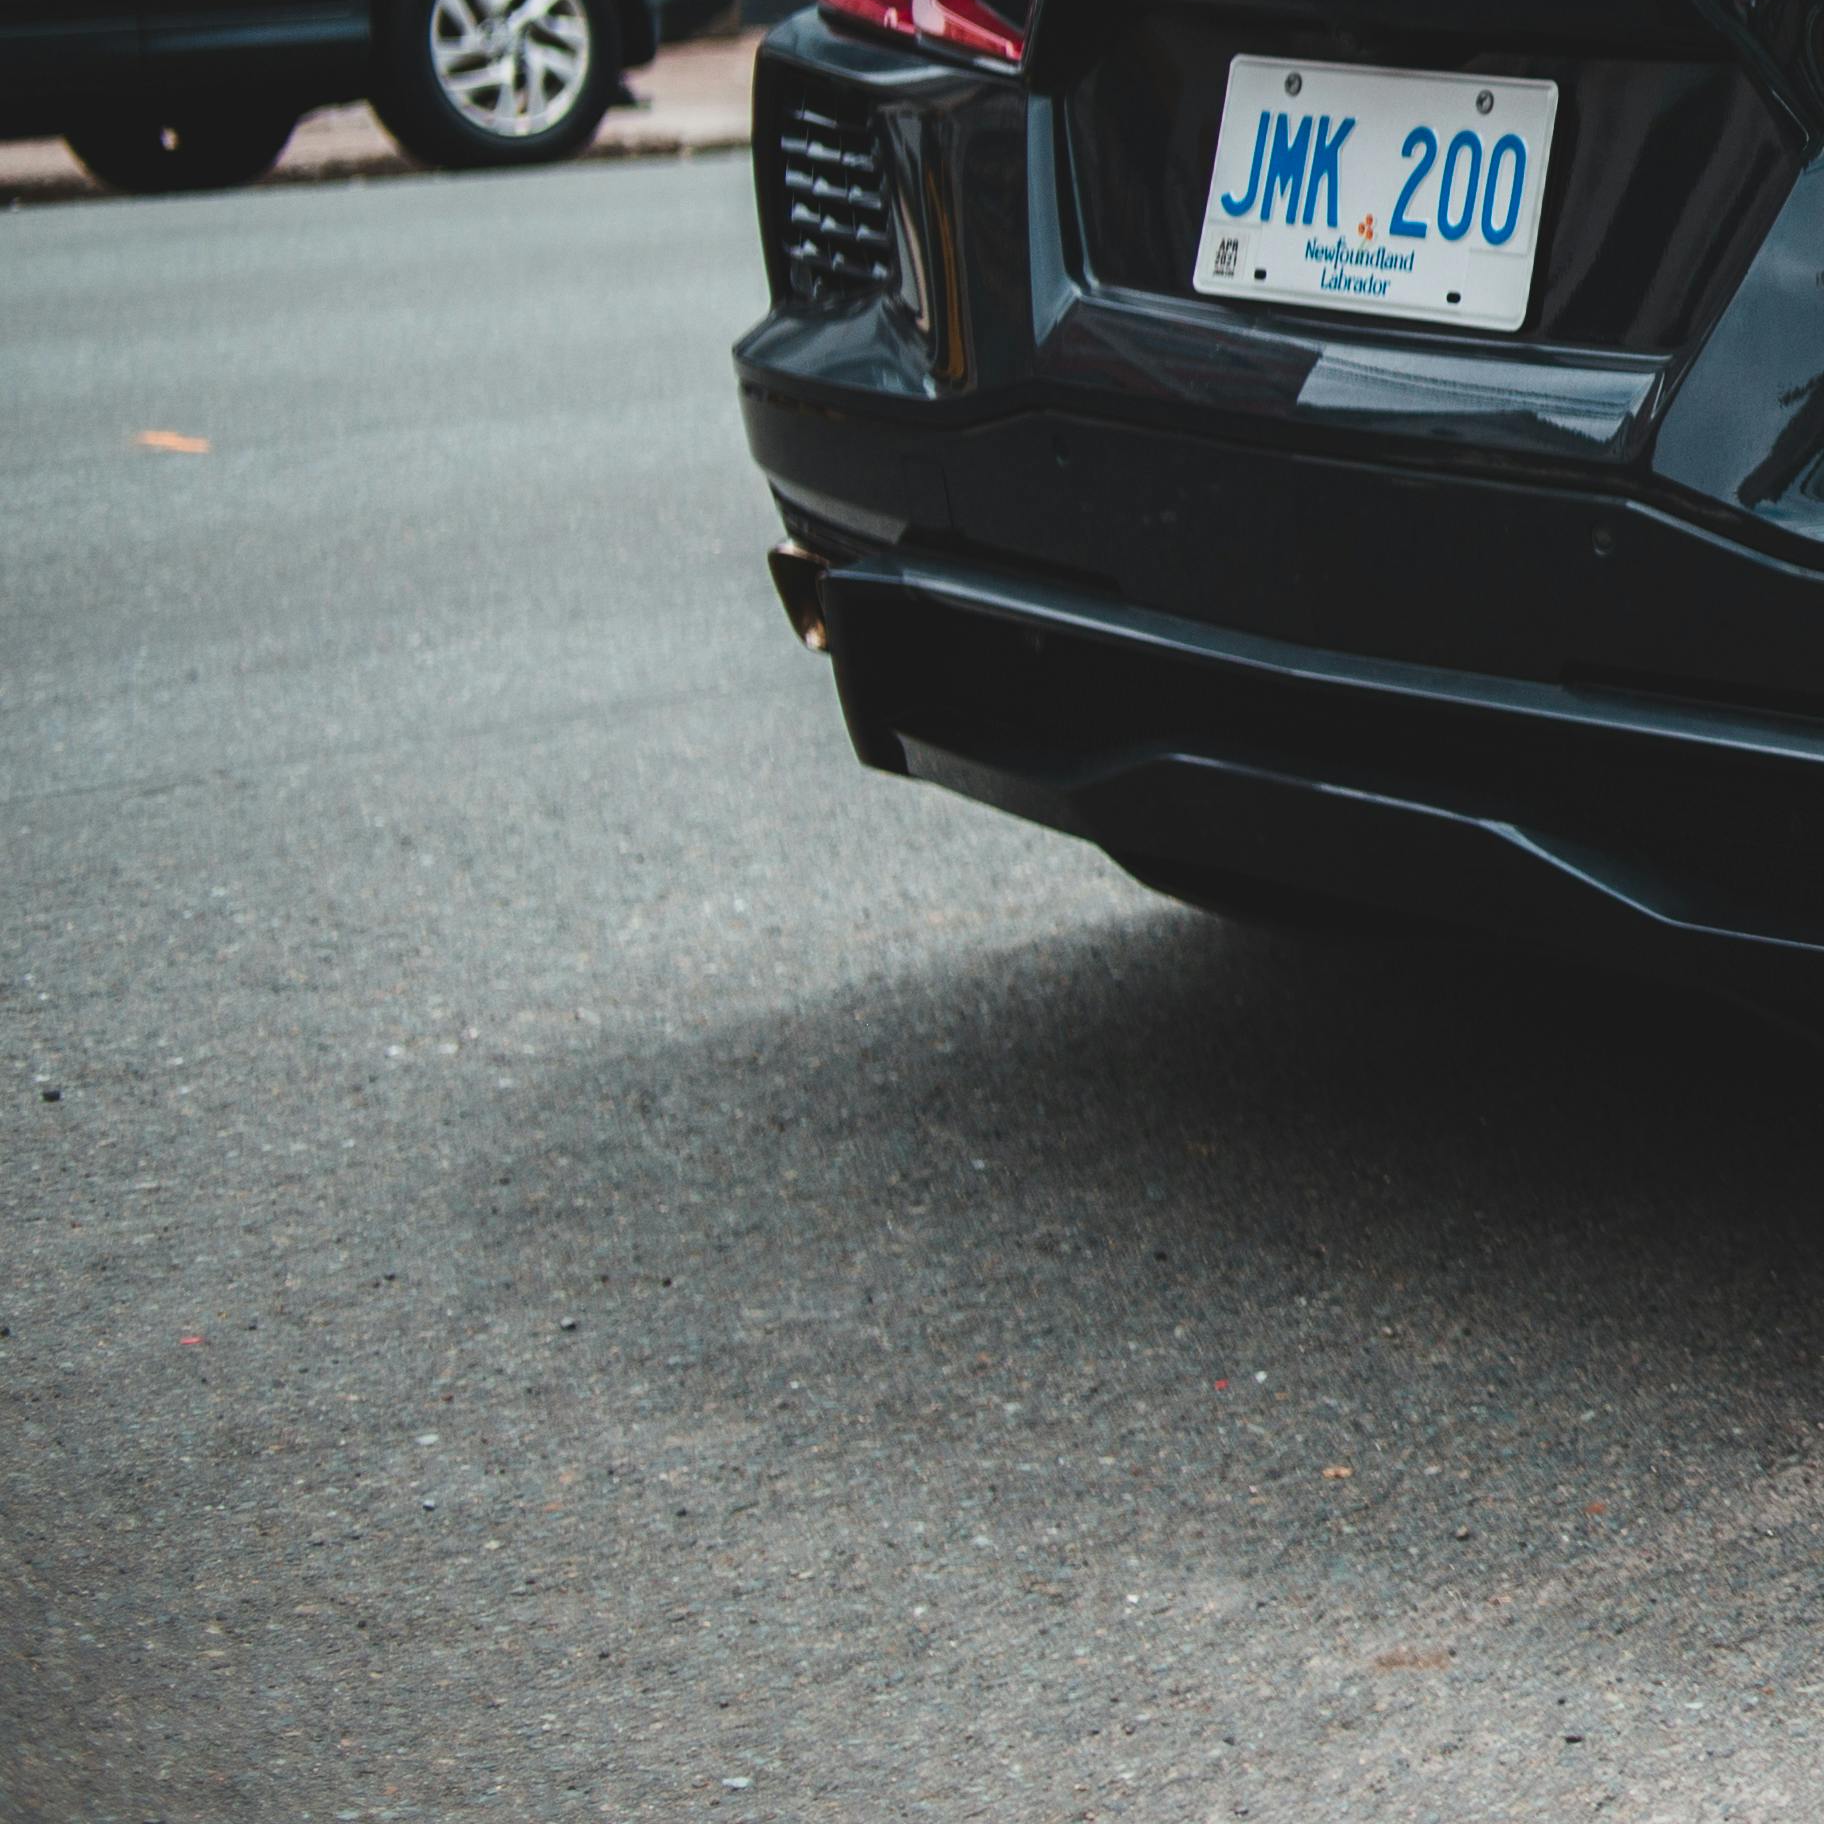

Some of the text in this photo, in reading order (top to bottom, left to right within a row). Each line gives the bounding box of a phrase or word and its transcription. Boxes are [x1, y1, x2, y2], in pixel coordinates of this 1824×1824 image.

[1220, 111, 1528, 246] JMK 200
[1218, 237, 1239, 253] APR
[1304, 235, 1415, 273] Newfoundland
[1319, 266, 1391, 296] Labrador
